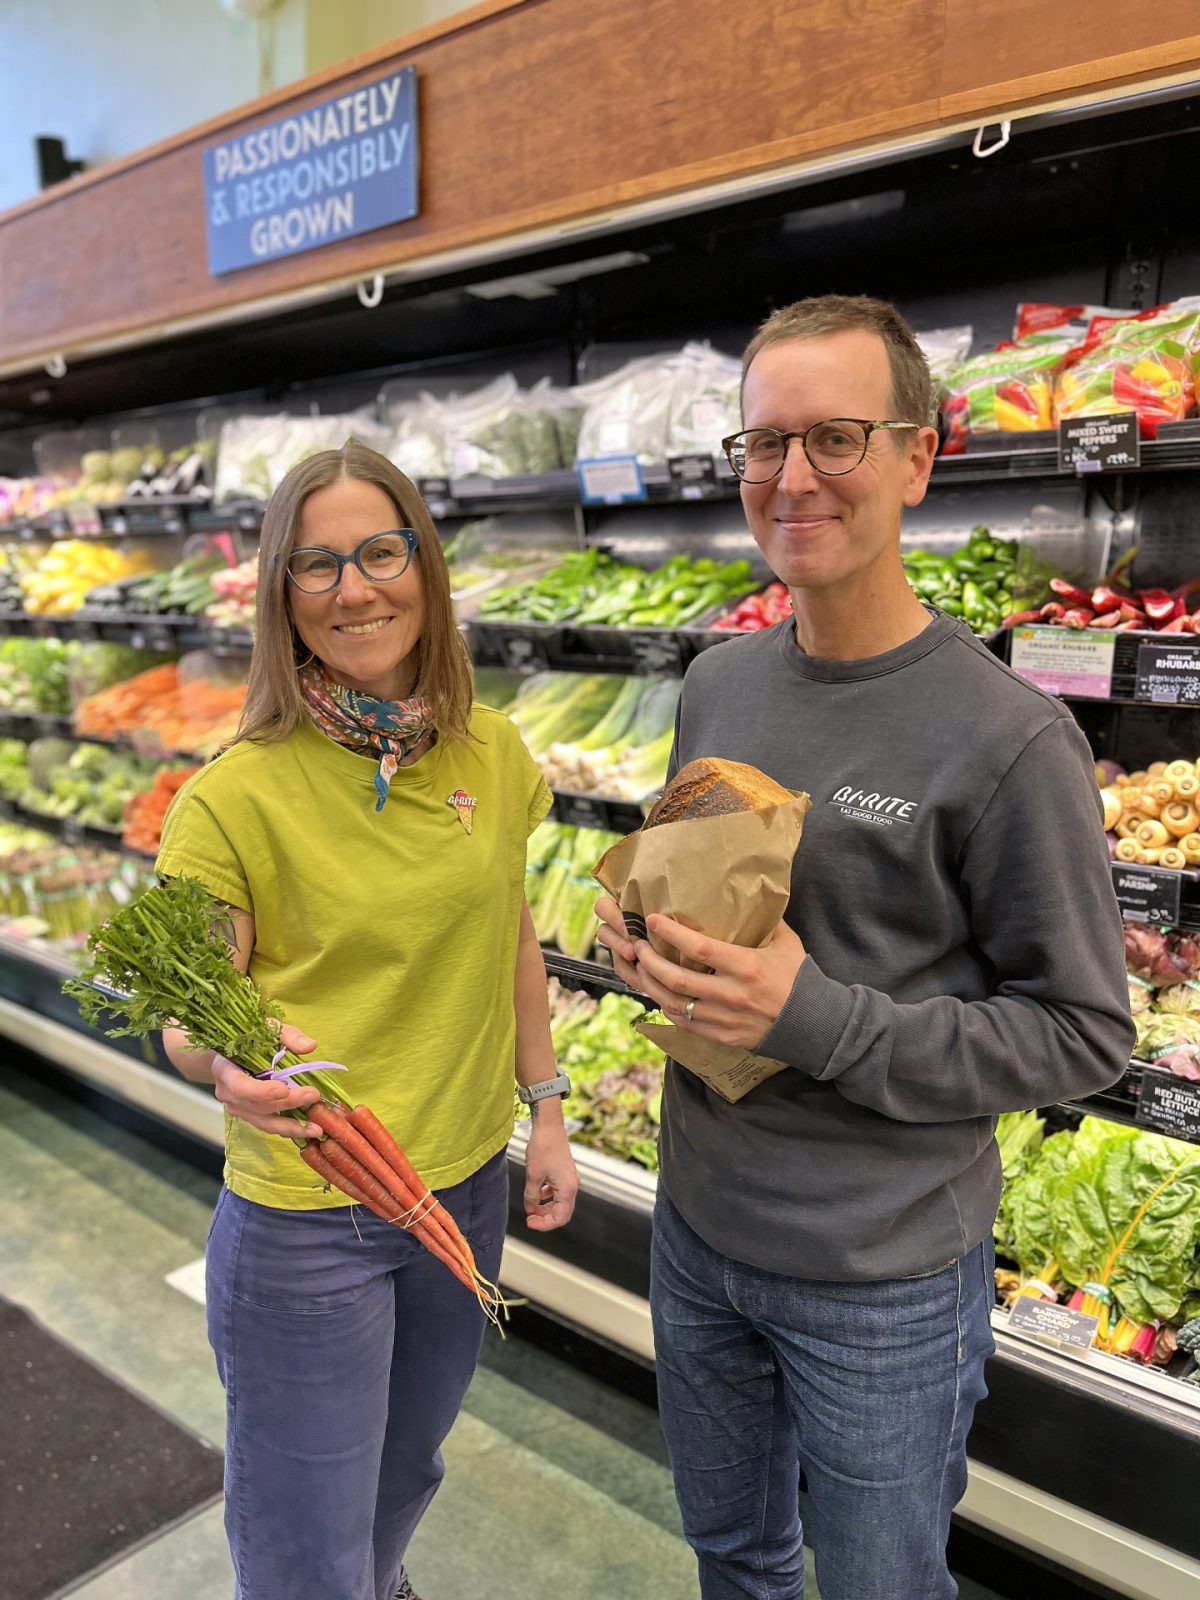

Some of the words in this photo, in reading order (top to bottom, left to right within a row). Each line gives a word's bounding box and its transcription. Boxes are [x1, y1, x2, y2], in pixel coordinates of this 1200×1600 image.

[214, 76, 401, 183] PASSIONATELY
[211, 190, 231, 226] &
[235, 122, 410, 219] RESPONSIBLY
[251, 192, 355, 255] GROWN
[1067, 427, 1097, 438] MIXED
[1098, 424, 1129, 435] SWEET
[1079, 434, 1117, 446] PEPPERS
[1028, 642, 1060, 650] ORGANIC
[1062, 644, 1097, 652] RHUBARB
[840, 807, 851, 815] EAT
[852, 810, 872, 820] GOOD
[873, 814, 893, 825] FOOD
[1154, 1086, 1173, 1099] RED
[1161, 1097, 1200, 1117] LETTUCE
[1032, 1306, 1079, 1325] RAINBOW
[1036, 1314, 1071, 1329] CHARD
